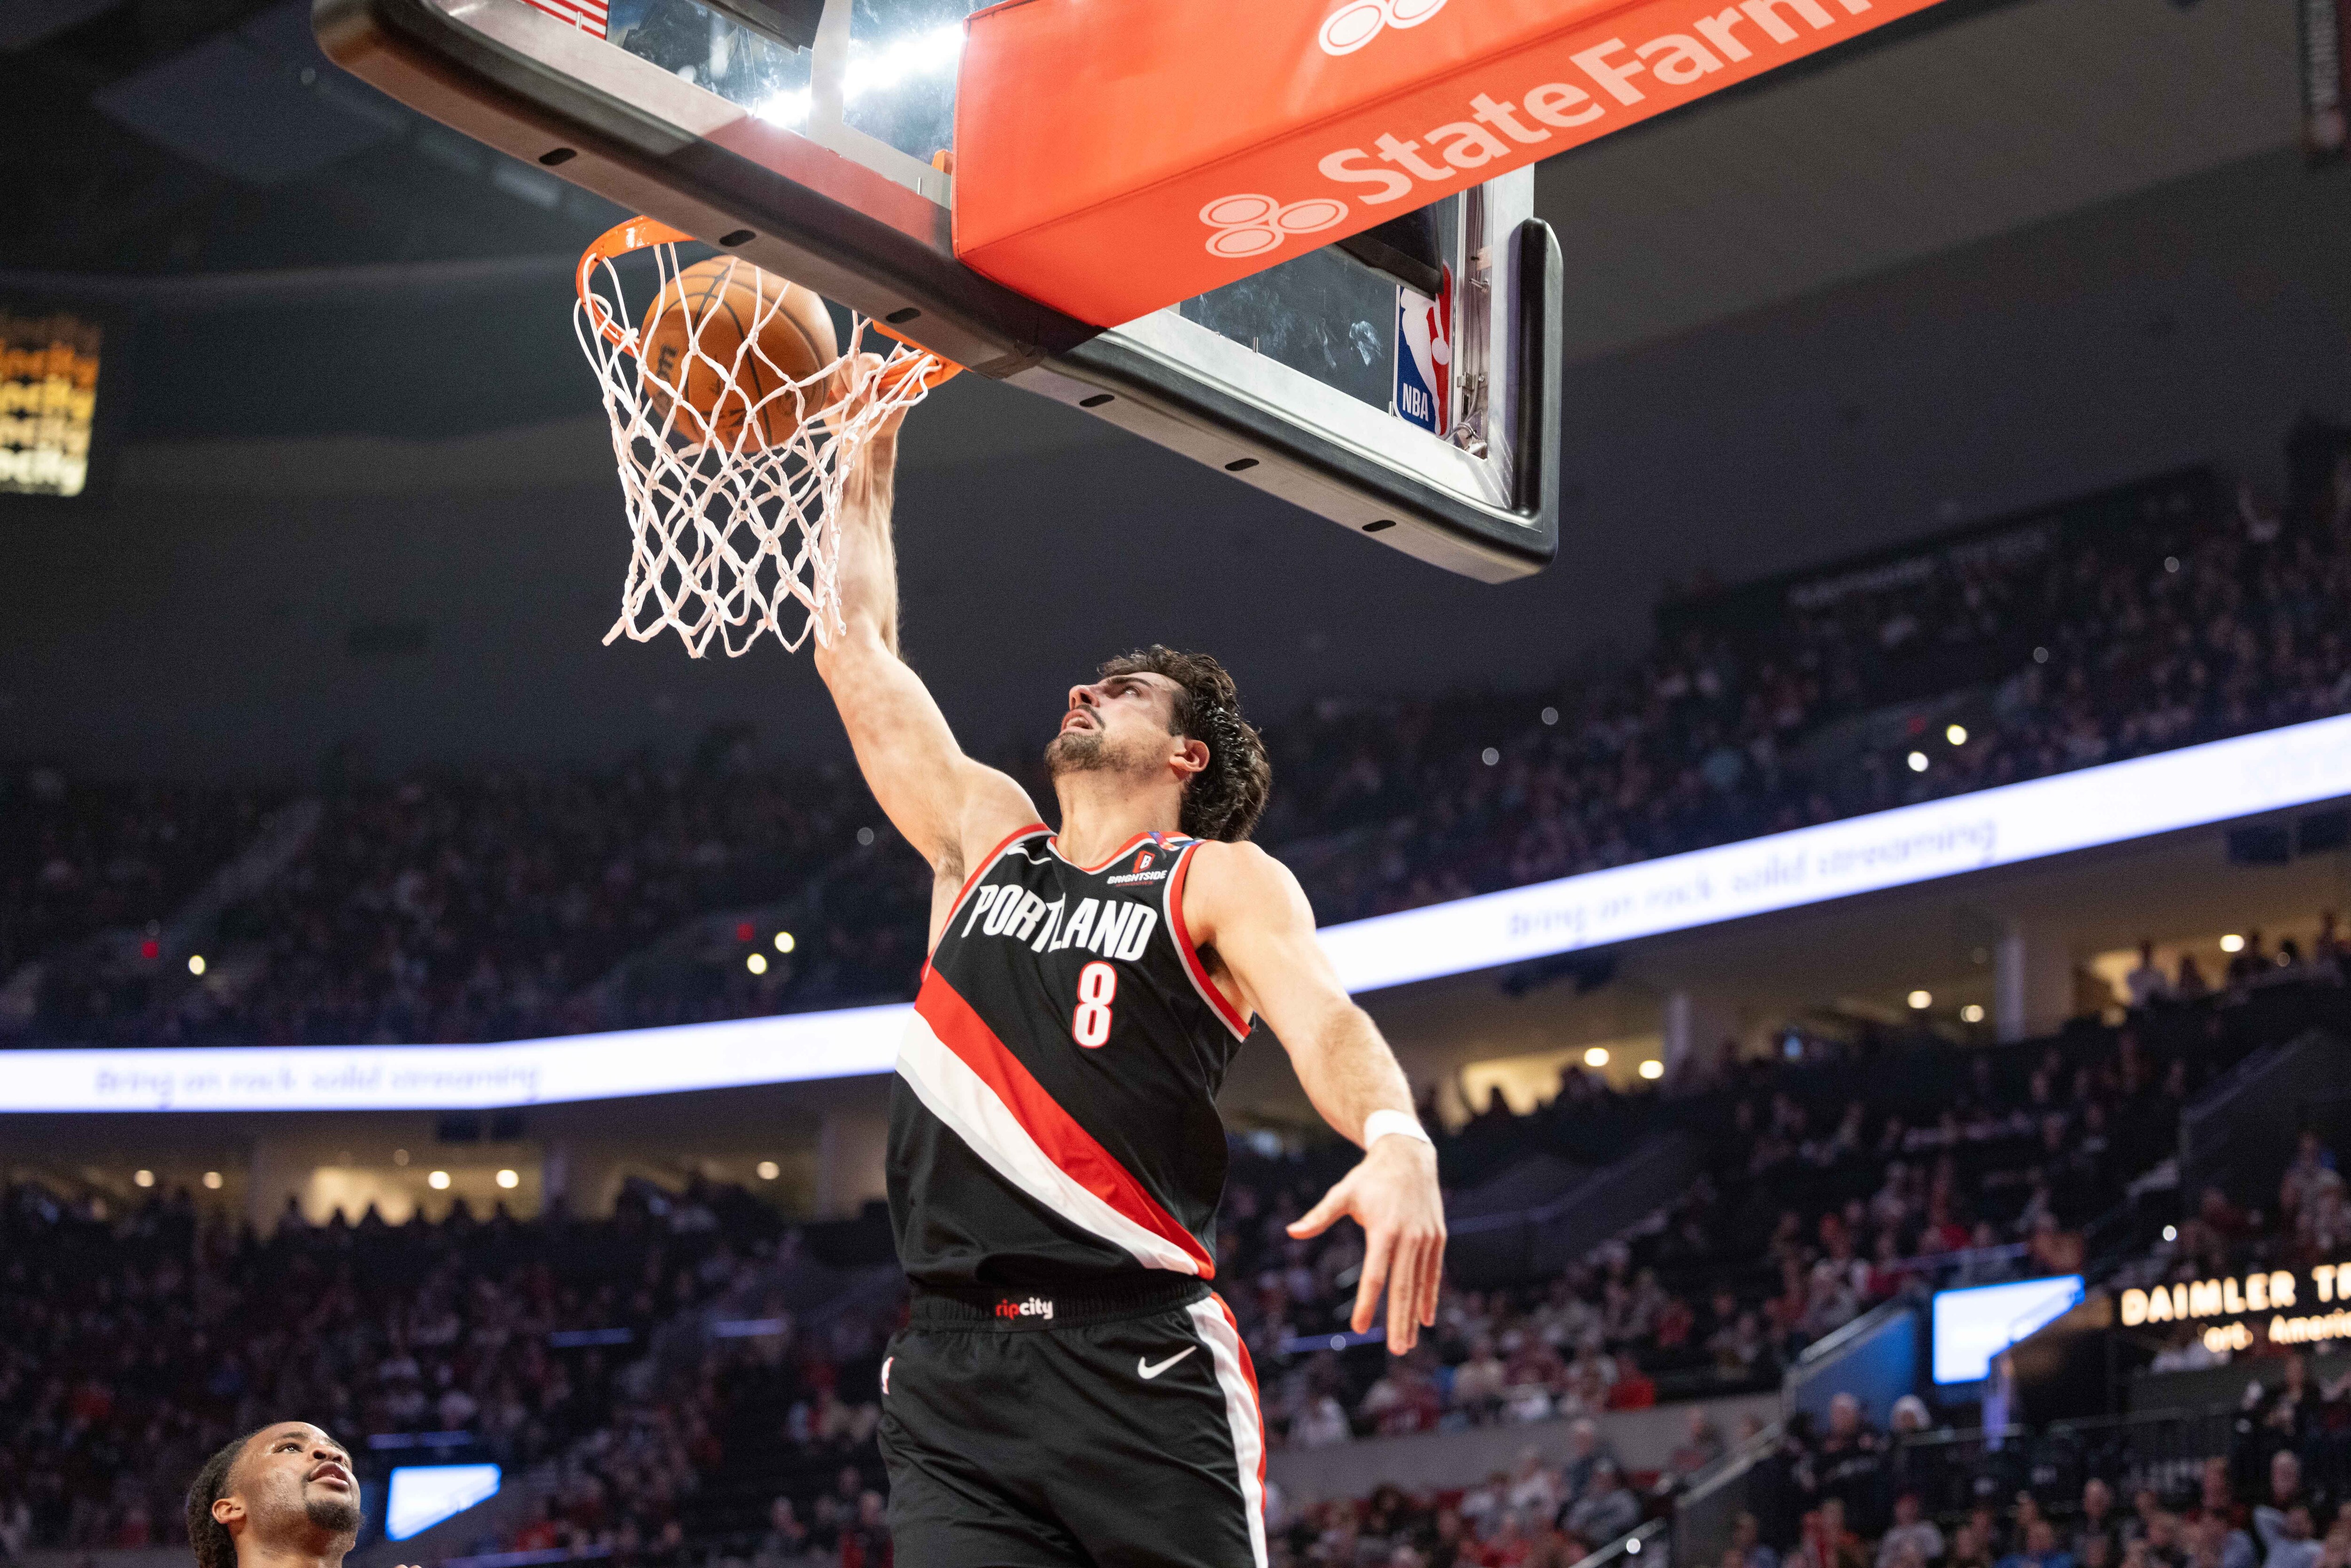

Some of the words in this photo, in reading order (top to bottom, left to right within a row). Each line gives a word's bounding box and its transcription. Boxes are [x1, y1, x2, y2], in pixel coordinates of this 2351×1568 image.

[1402, 382, 1428, 422] NBA
[1106, 870, 1167, 884] BRIGHTSIDE
[1140, 855, 1152, 869] B
[961, 884, 1158, 961] PORTLAND
[1073, 961, 1117, 1048] 8
[995, 1297, 1053, 1320] ripcity
[2121, 1270, 2296, 1326] DAIMLER
